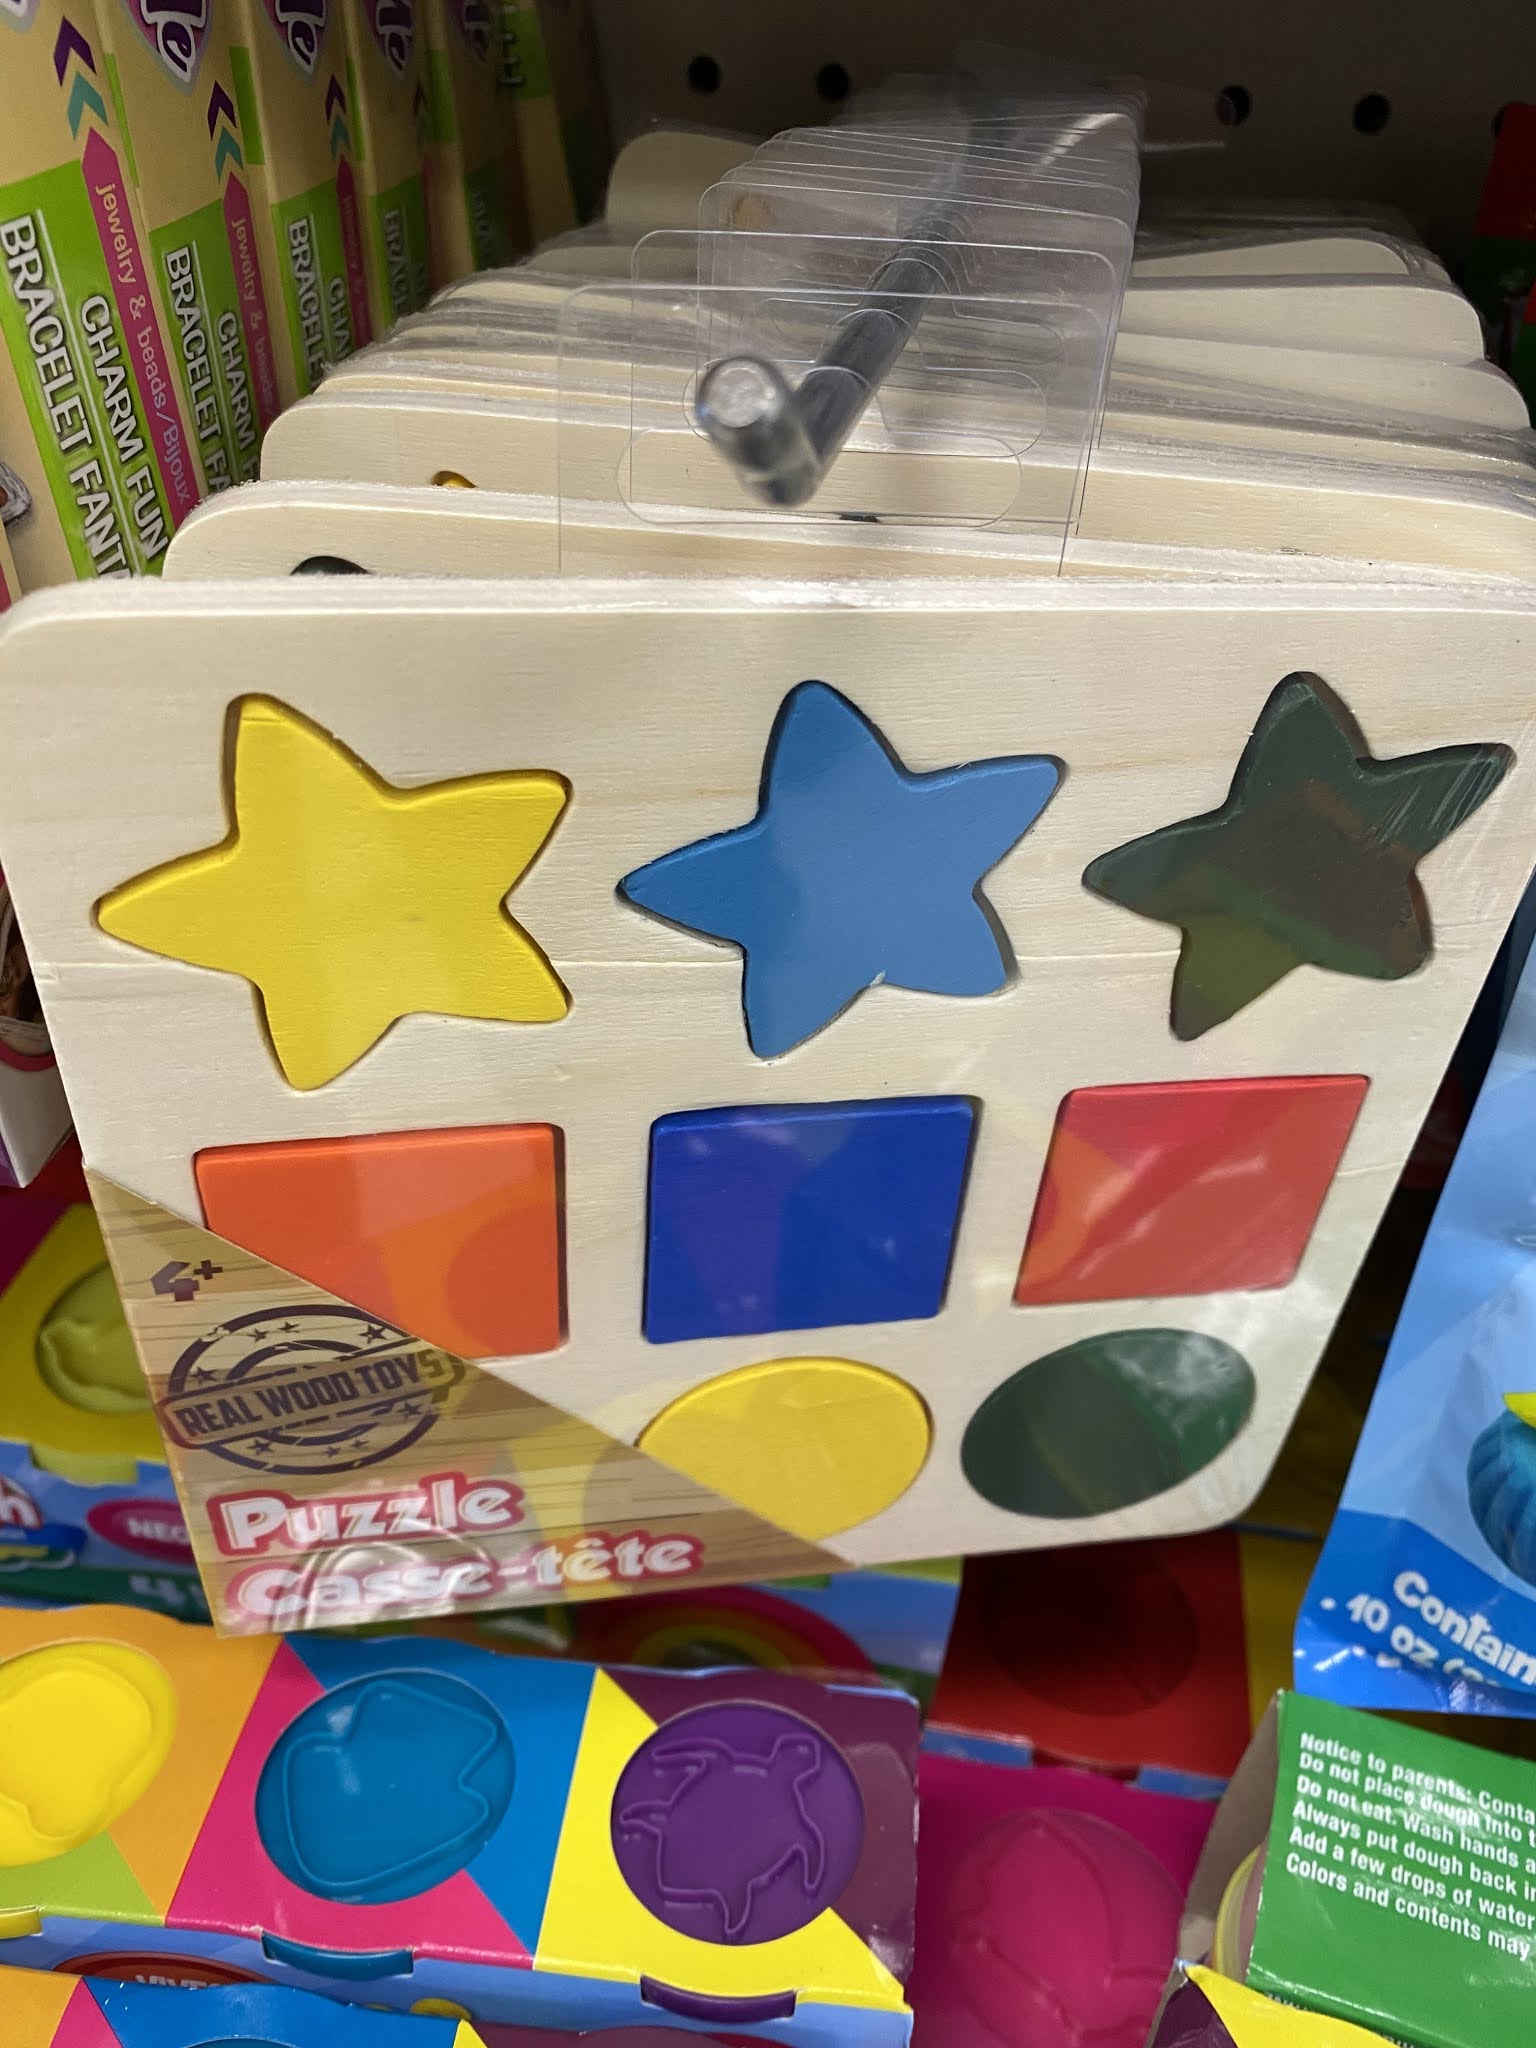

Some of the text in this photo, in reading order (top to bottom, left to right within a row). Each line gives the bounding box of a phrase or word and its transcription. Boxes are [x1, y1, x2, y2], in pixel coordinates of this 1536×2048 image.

[95, 184, 137, 284] jewelry
[128, 294, 147, 320] &
[166, 246, 222, 440] BRACELET
[218, 312, 256, 450] CHARM
[0, 215, 132, 578] BRACELET FANT
[81, 296, 169, 559] CHARM FUN
[174, 1348, 445, 1438] REAL WOOD TOYS
[217, 1477, 515, 1551] Puzzle
[235, 1534, 697, 1617] Casse-tête
[1346, 1593, 1390, 1633] 10
[1299, 1752, 1324, 1773] Do
[1329, 1763, 1360, 1786] not
[1364, 1774, 1415, 1805] place
[1419, 1792, 1480, 1829] dough
[1301, 1732, 1362, 1765] Notice
[1367, 1752, 1387, 1774] to
[1392, 1763, 1472, 1804] parents:
[1292, 1799, 1361, 1839] Always
[1366, 1829, 1398, 1855] put
[1403, 1841, 1464, 1876] dough
[1469, 1861, 1518, 1897] back
[1297, 1774, 1322, 1797] Do
[1326, 1787, 1358, 1811] not
[1361, 1800, 1397, 1825] eat.
[1403, 1811, 1454, 1846] Wash
[1460, 1831, 1519, 1869] hands
[1286, 1852, 1531, 1962] Colors and contents may
[1289, 1826, 1536, 1930] Add a few drops of water
